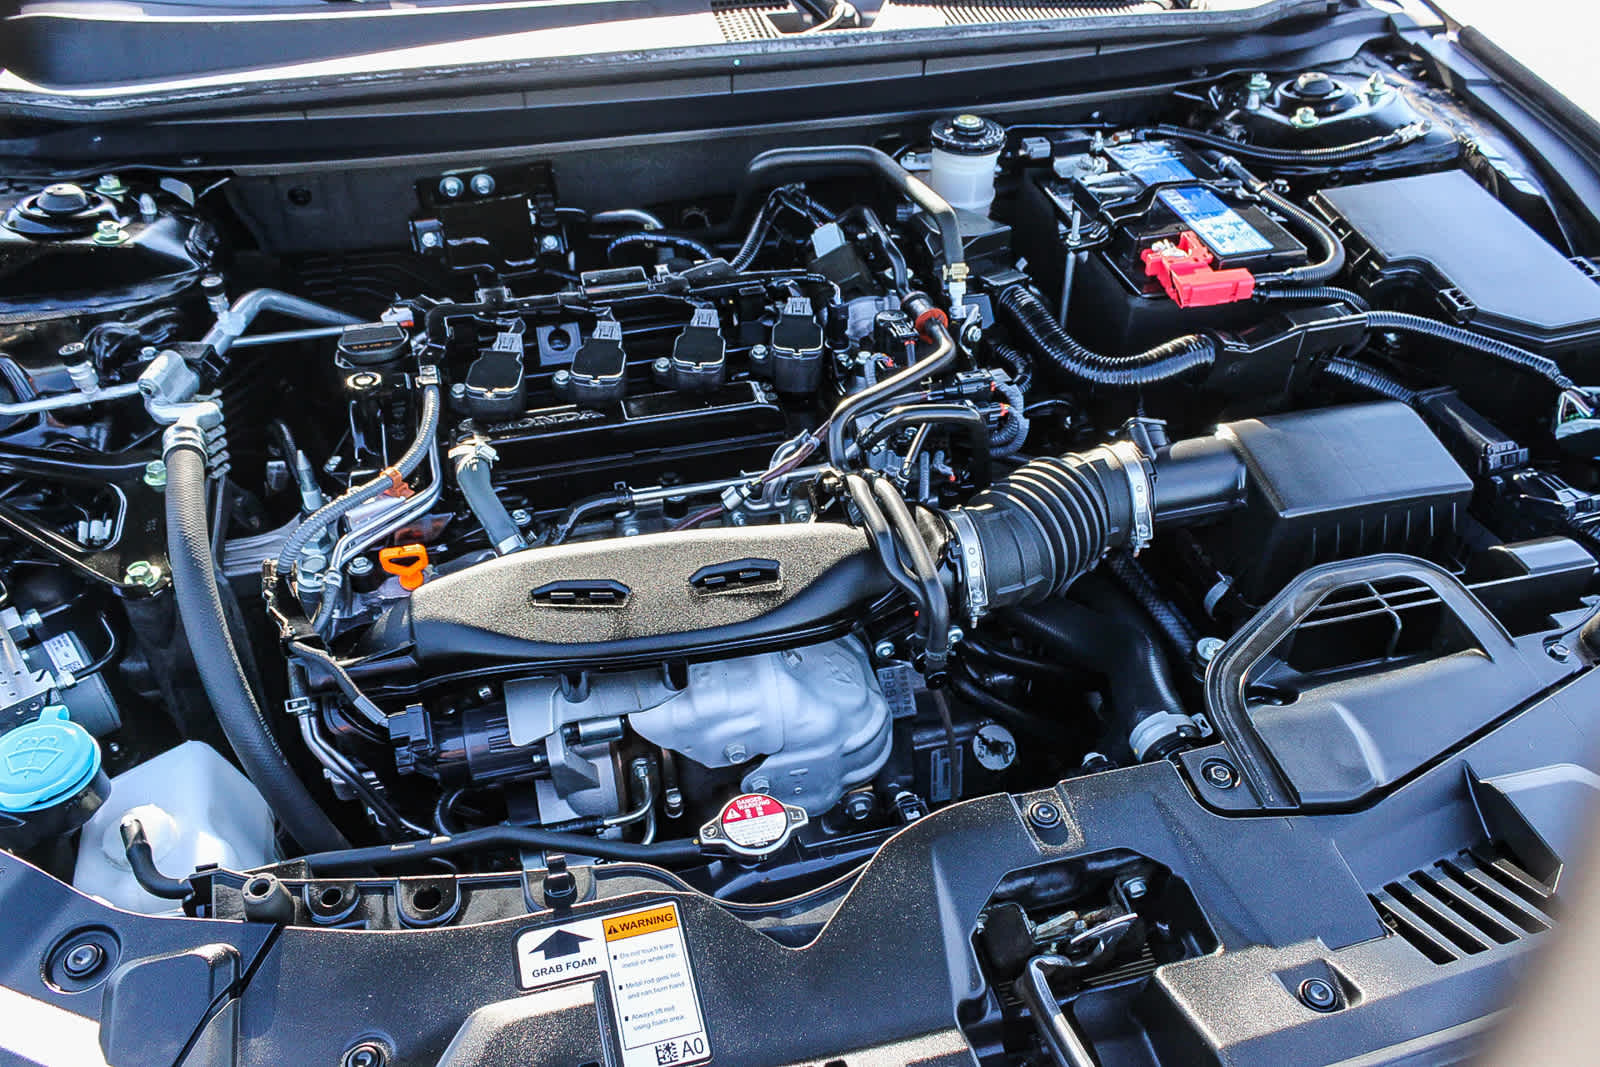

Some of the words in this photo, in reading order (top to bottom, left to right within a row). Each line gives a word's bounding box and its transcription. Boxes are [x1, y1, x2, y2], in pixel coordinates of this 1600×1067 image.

[618, 913, 674, 931] WARNING
[532, 964, 564, 978] GRAB
[566, 956, 597, 971] FOAM
[682, 1037, 704, 1058] A0
